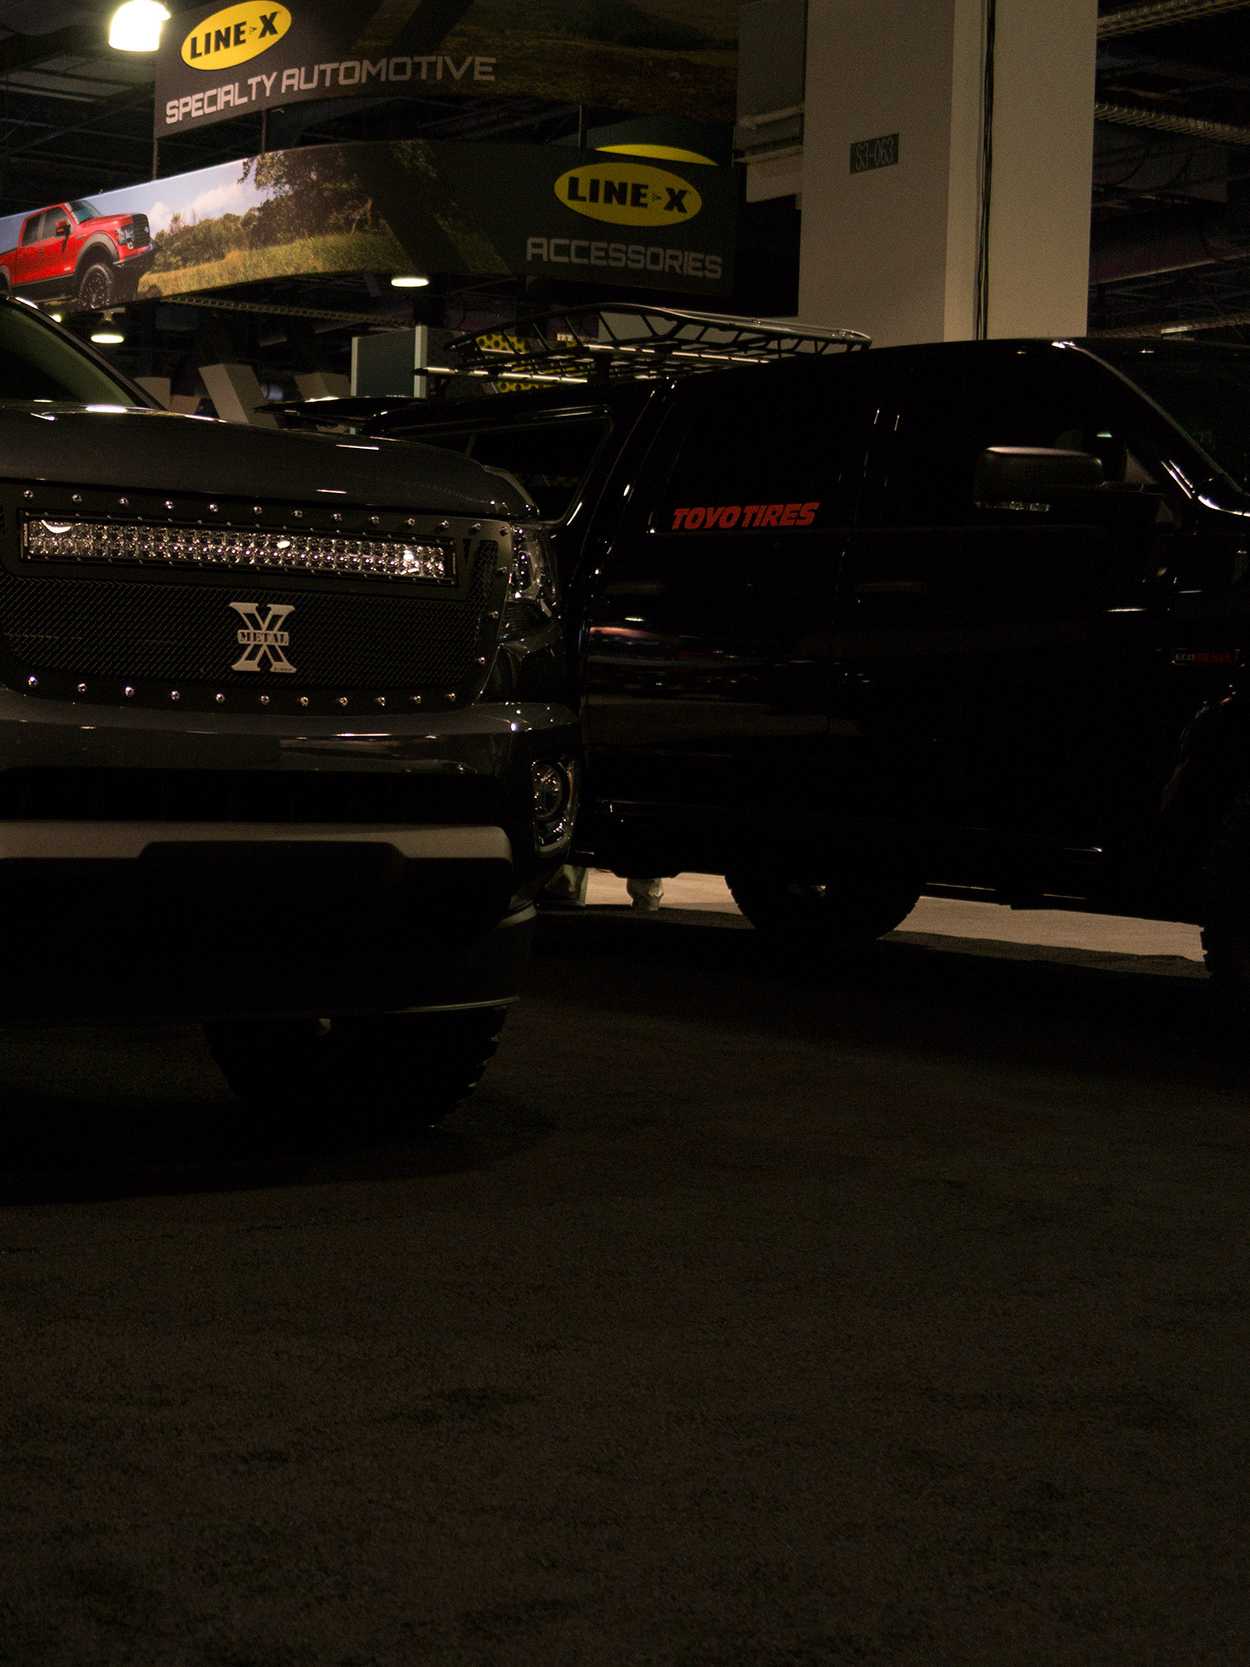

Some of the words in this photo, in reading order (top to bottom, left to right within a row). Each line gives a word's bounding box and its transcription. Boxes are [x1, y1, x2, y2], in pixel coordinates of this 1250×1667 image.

[165, 72, 277, 124] SPECIALTY
[281, 56, 497, 94] AUTOMOTIVE
[526, 237, 723, 280] ACCESSORIES
[671, 504, 742, 531] TOYO
[741, 501, 821, 528] TIRES
[239, 631, 288, 645] METAL
